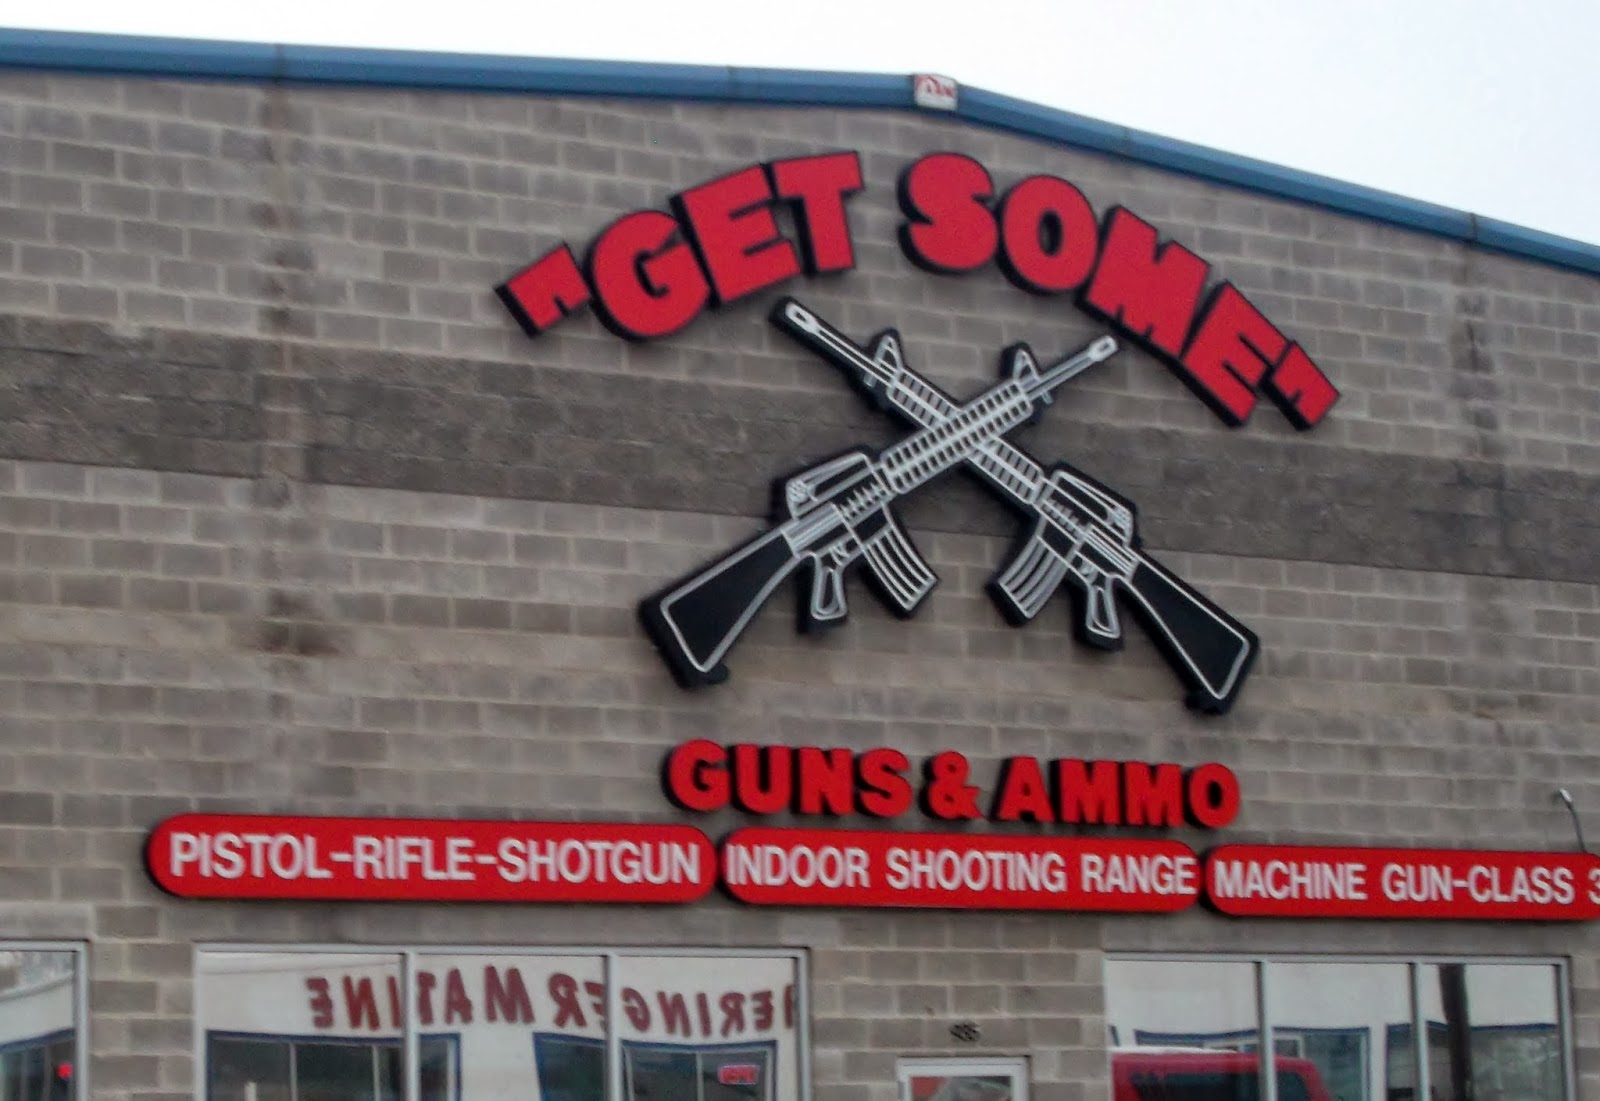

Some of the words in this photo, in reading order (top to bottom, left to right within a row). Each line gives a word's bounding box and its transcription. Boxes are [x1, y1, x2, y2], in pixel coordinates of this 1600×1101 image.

[505, 152, 863, 338] "GET
[900, 154, 1339, 428] SOME"
[670, 739, 911, 816] GUNS
[928, 751, 981, 819] &
[1000, 757, 1240, 828] AMMO
[170, 832, 700, 884] PISTOL-RIFLE-SHOTGUN
[727, 844, 868, 888] INDOOR
[886, 848, 1066, 894] SHOOTING
[1081, 854, 1196, 896] RANGE
[1214, 860, 1367, 900] MACHINE
[1381, 863, 1575, 904] GUN-CLASS
